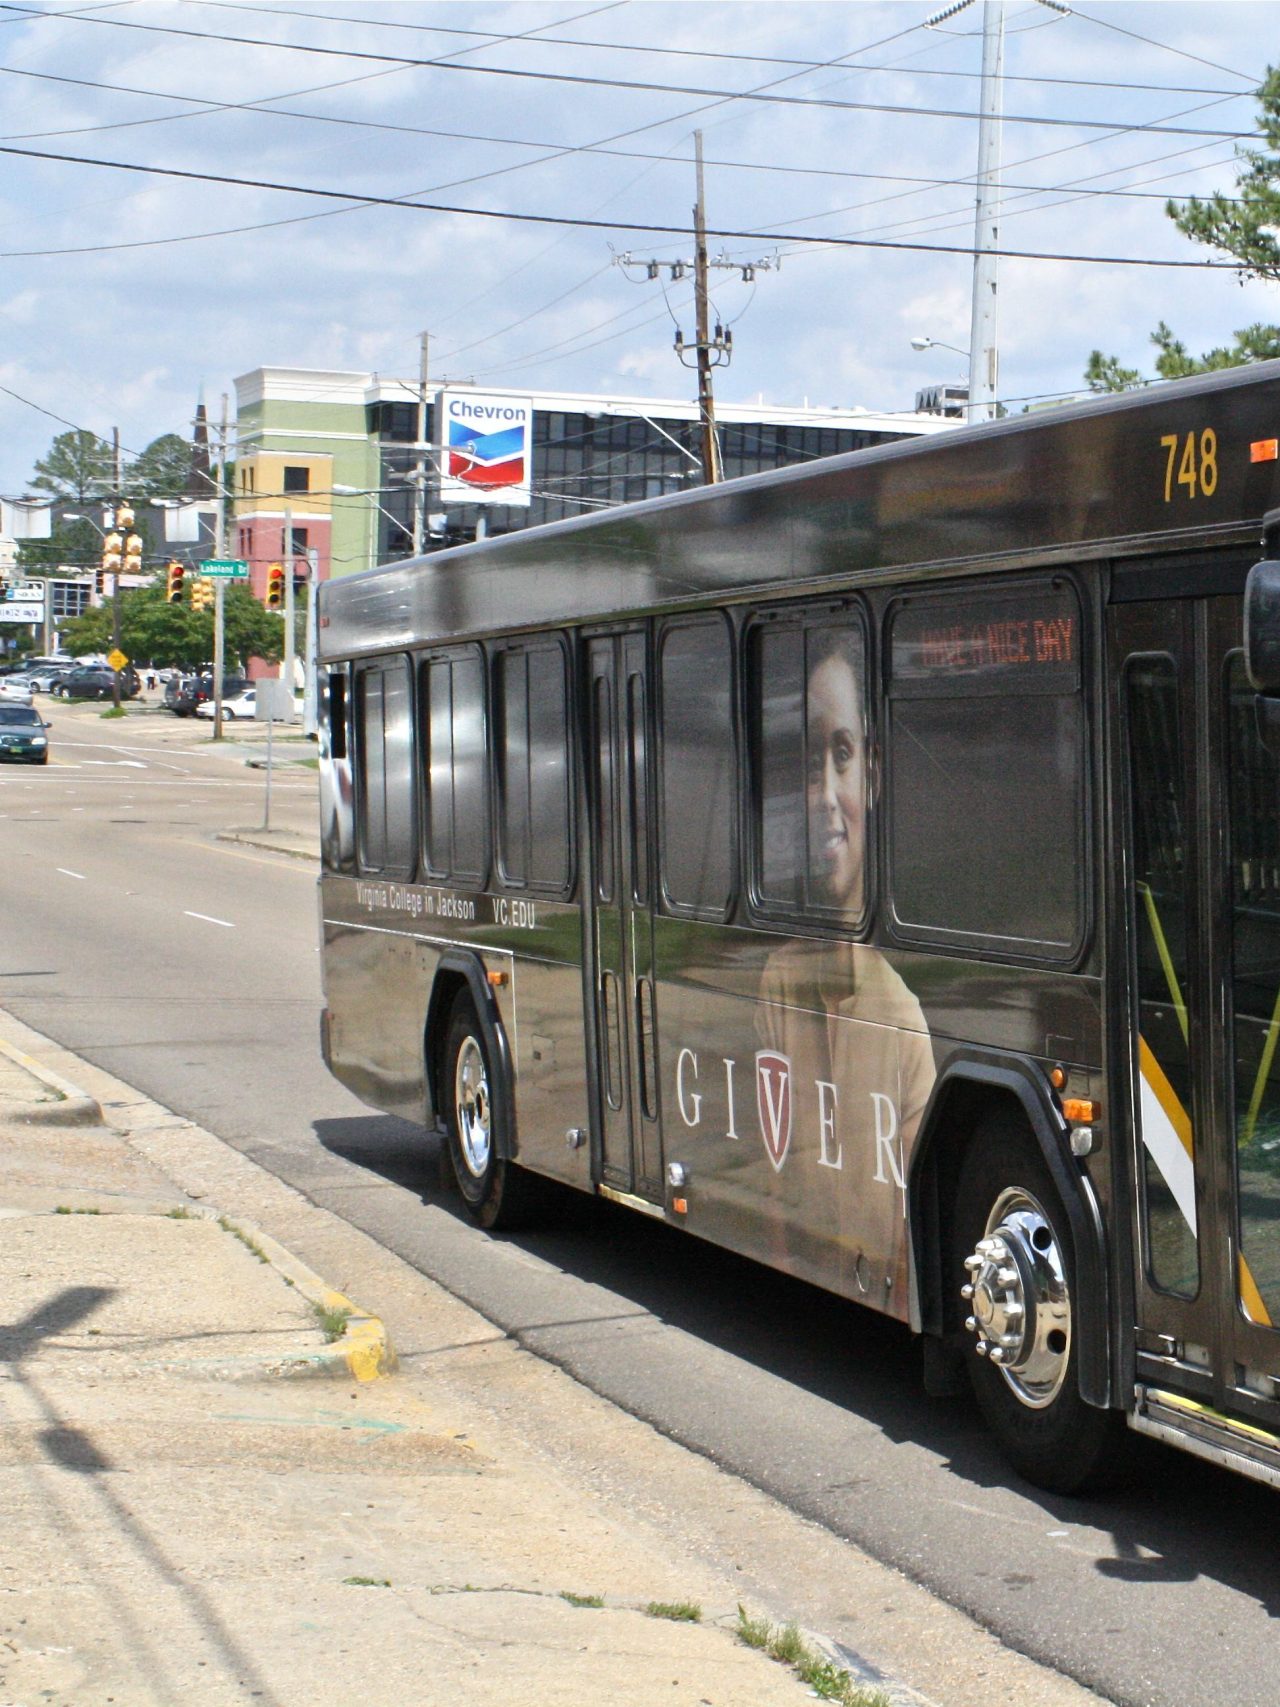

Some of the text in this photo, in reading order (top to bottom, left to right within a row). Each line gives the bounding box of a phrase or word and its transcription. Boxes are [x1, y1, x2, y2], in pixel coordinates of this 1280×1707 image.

[448, 400, 526, 421] Chevron
[1160, 427, 1218, 503] 748
[1033, 617, 1073, 662] DAY
[357, 882, 536, 930] Virginia College in Jackson VC.EDU
[677, 1048, 908, 1190] GIVER
